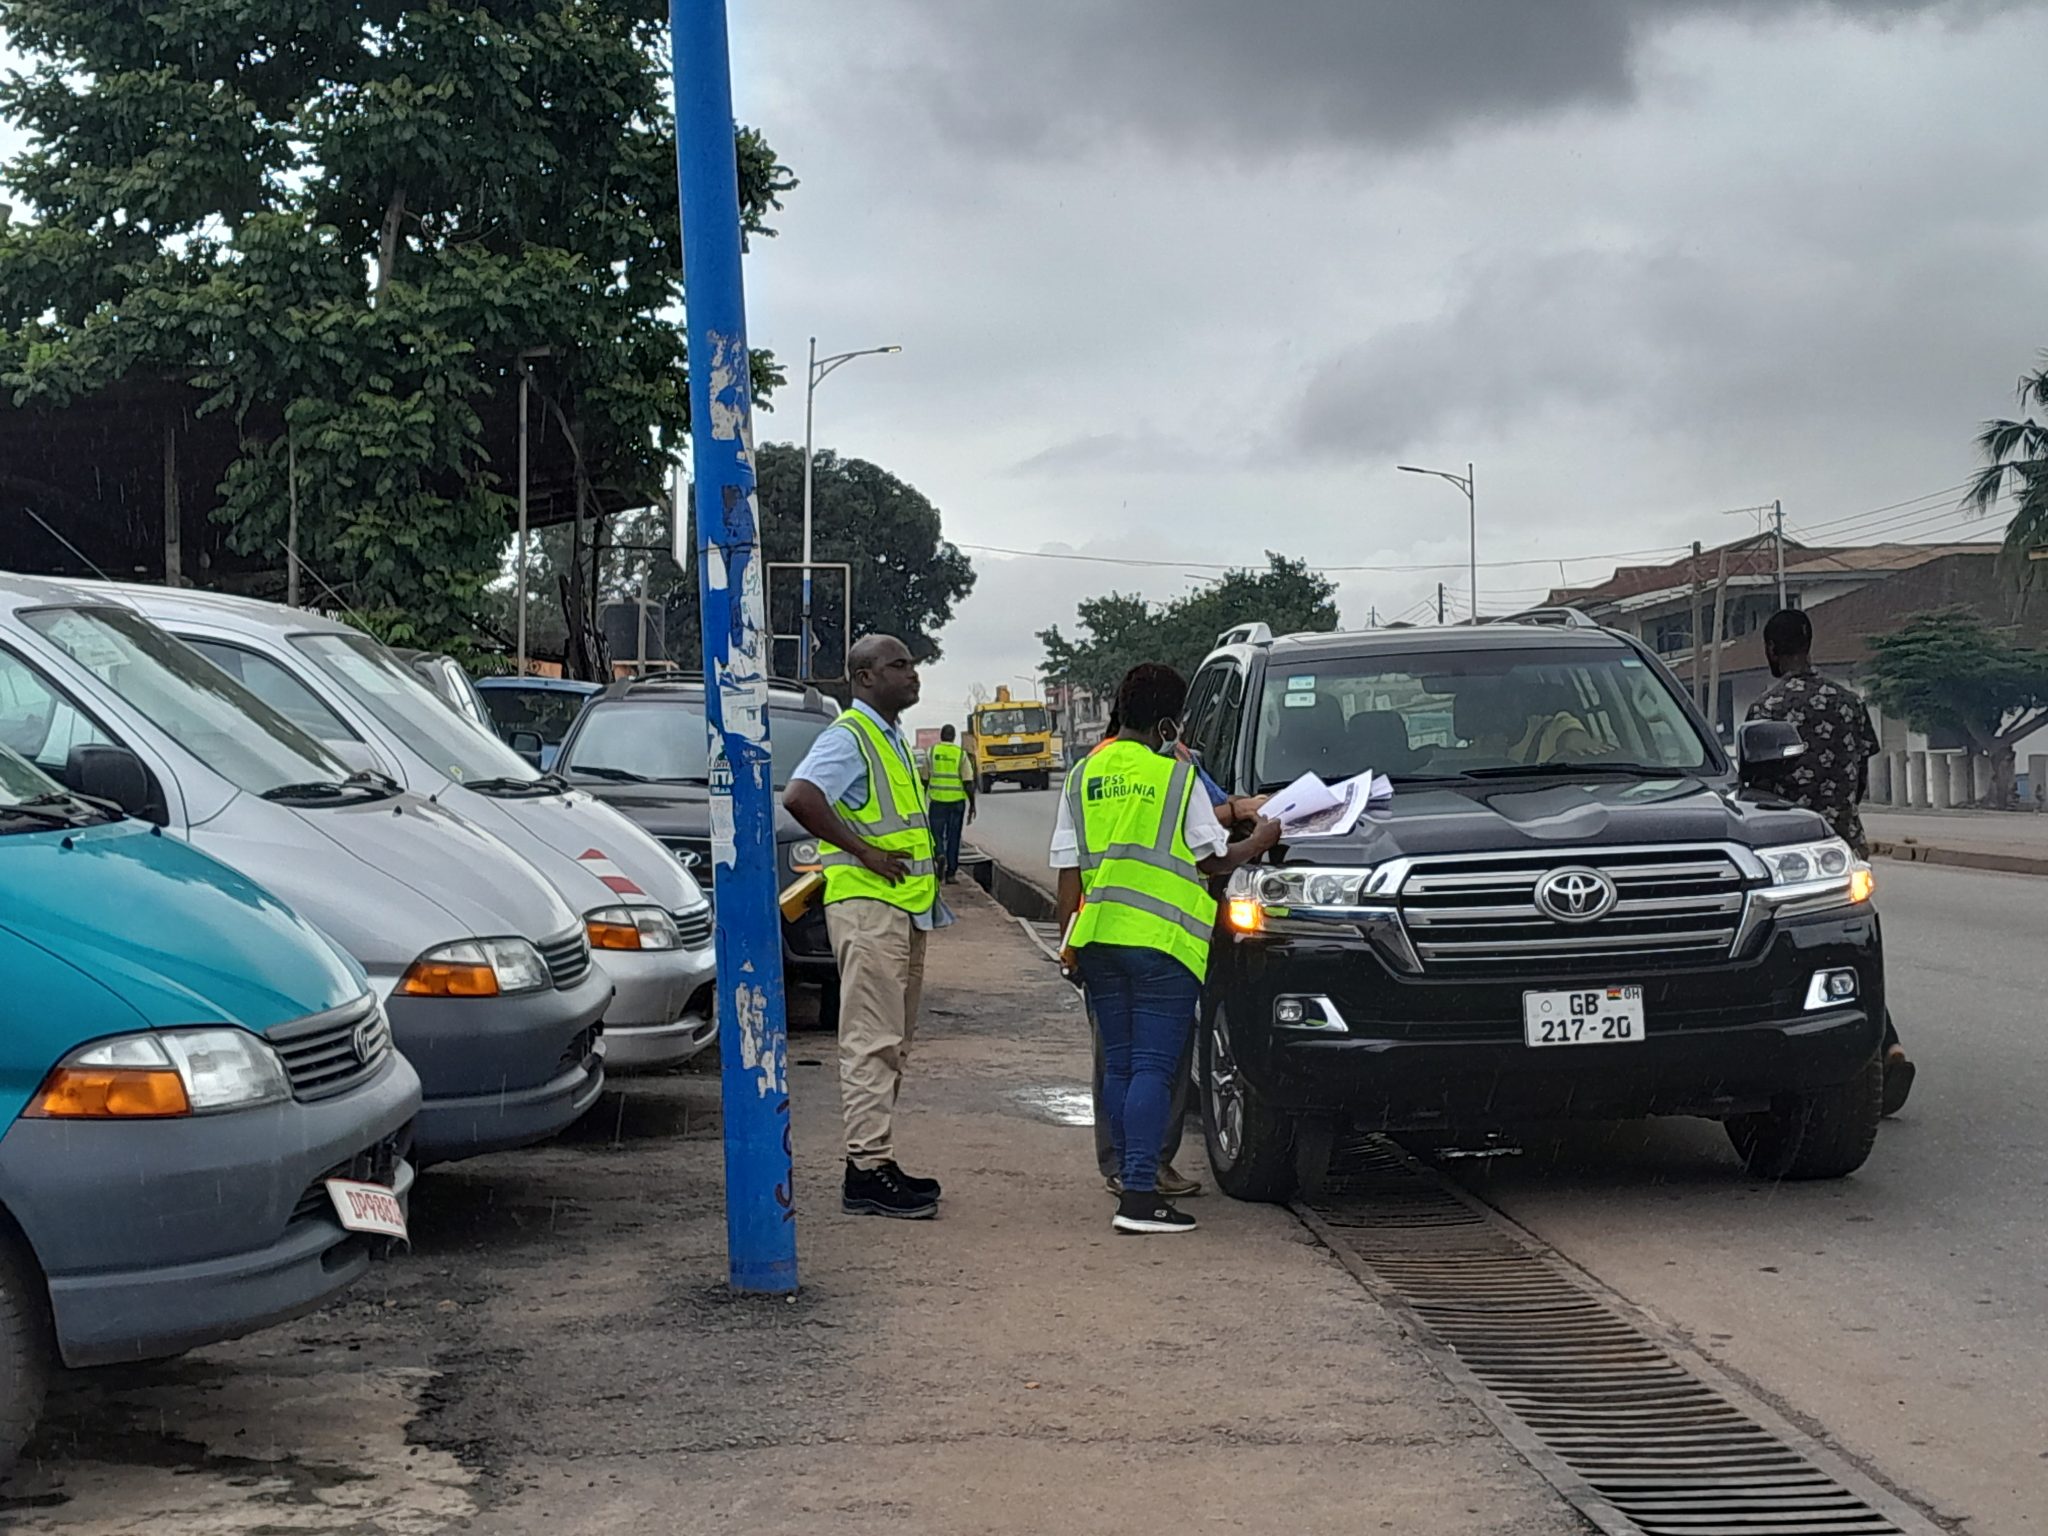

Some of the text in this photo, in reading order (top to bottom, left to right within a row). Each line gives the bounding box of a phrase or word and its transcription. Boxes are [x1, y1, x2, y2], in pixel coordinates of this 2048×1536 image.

[1103, 774, 1125, 786] PSS
[1569, 993, 1600, 1015] GB
[1541, 1015, 1631, 1042] 217-20
